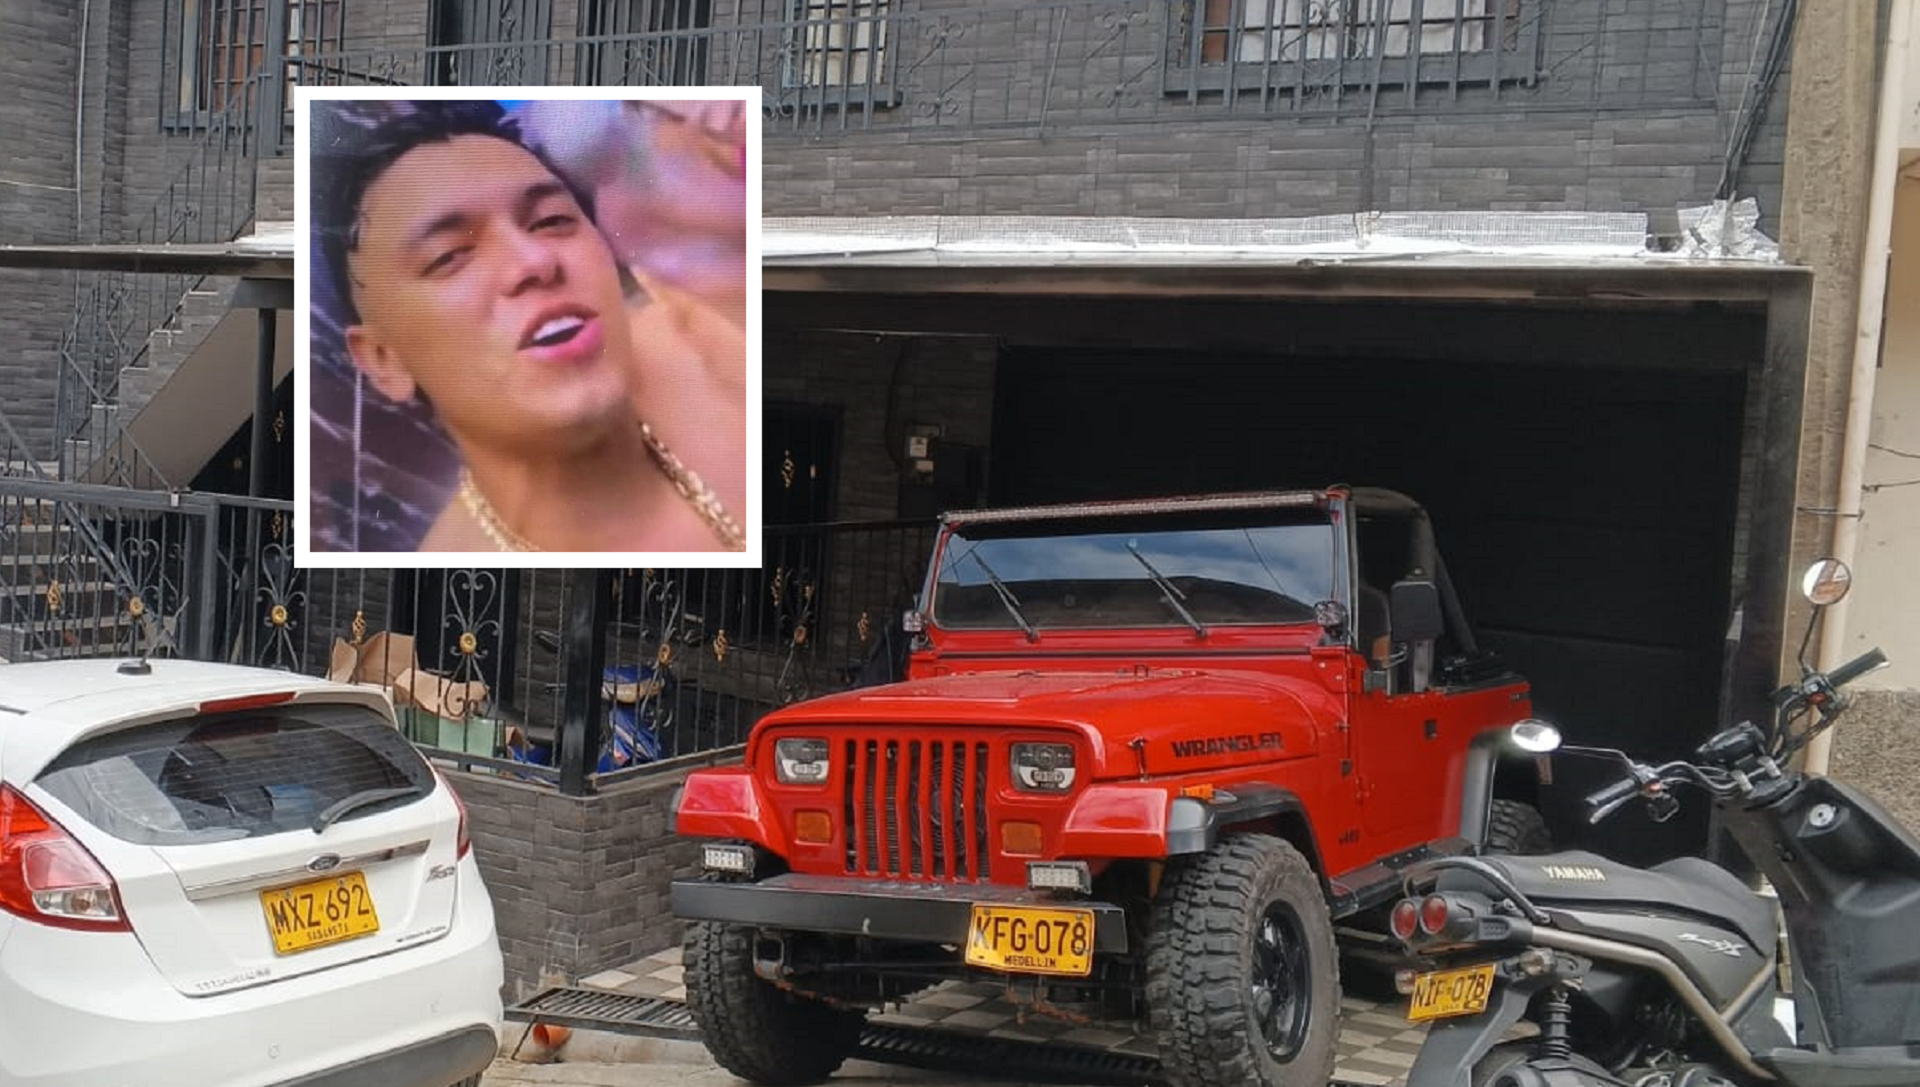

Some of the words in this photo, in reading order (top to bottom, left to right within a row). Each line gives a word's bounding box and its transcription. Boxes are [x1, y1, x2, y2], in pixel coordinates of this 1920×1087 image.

[1170, 732, 1284, 758] WRANGLER
[1541, 866, 1606, 881] YAMAHA
[270, 893, 322, 935] MXZ
[325, 884, 370, 922] 692
[1004, 955, 1057, 967] MEDELLIN
